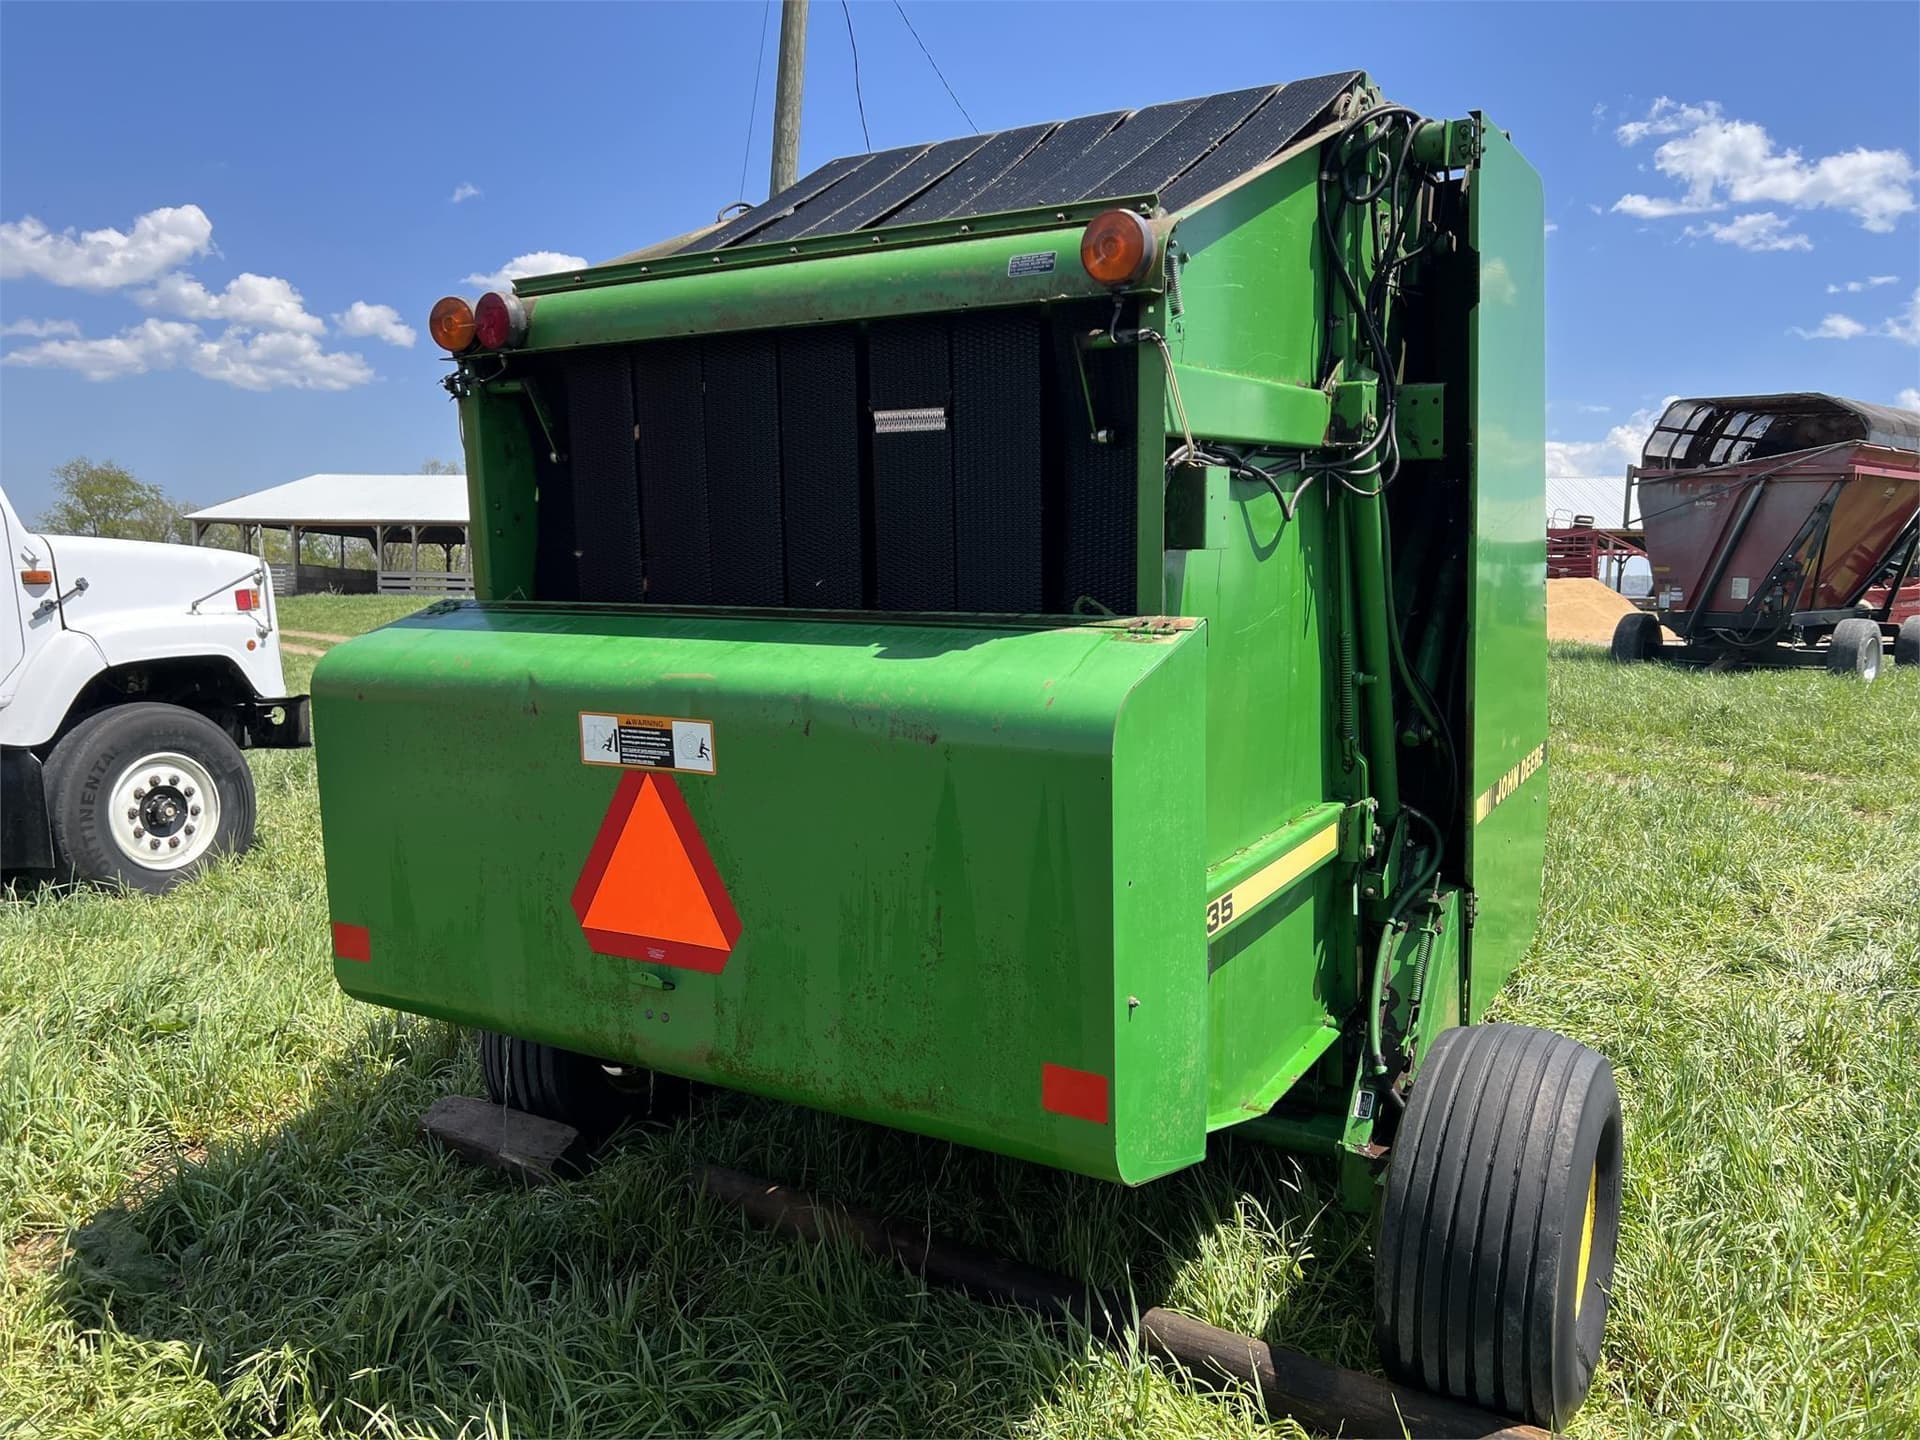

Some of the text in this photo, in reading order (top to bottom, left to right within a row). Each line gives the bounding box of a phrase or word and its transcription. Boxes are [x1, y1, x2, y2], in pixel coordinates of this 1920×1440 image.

[632, 718, 664, 728] WARNING
[1496, 743, 1544, 805] JOHN DEERE
